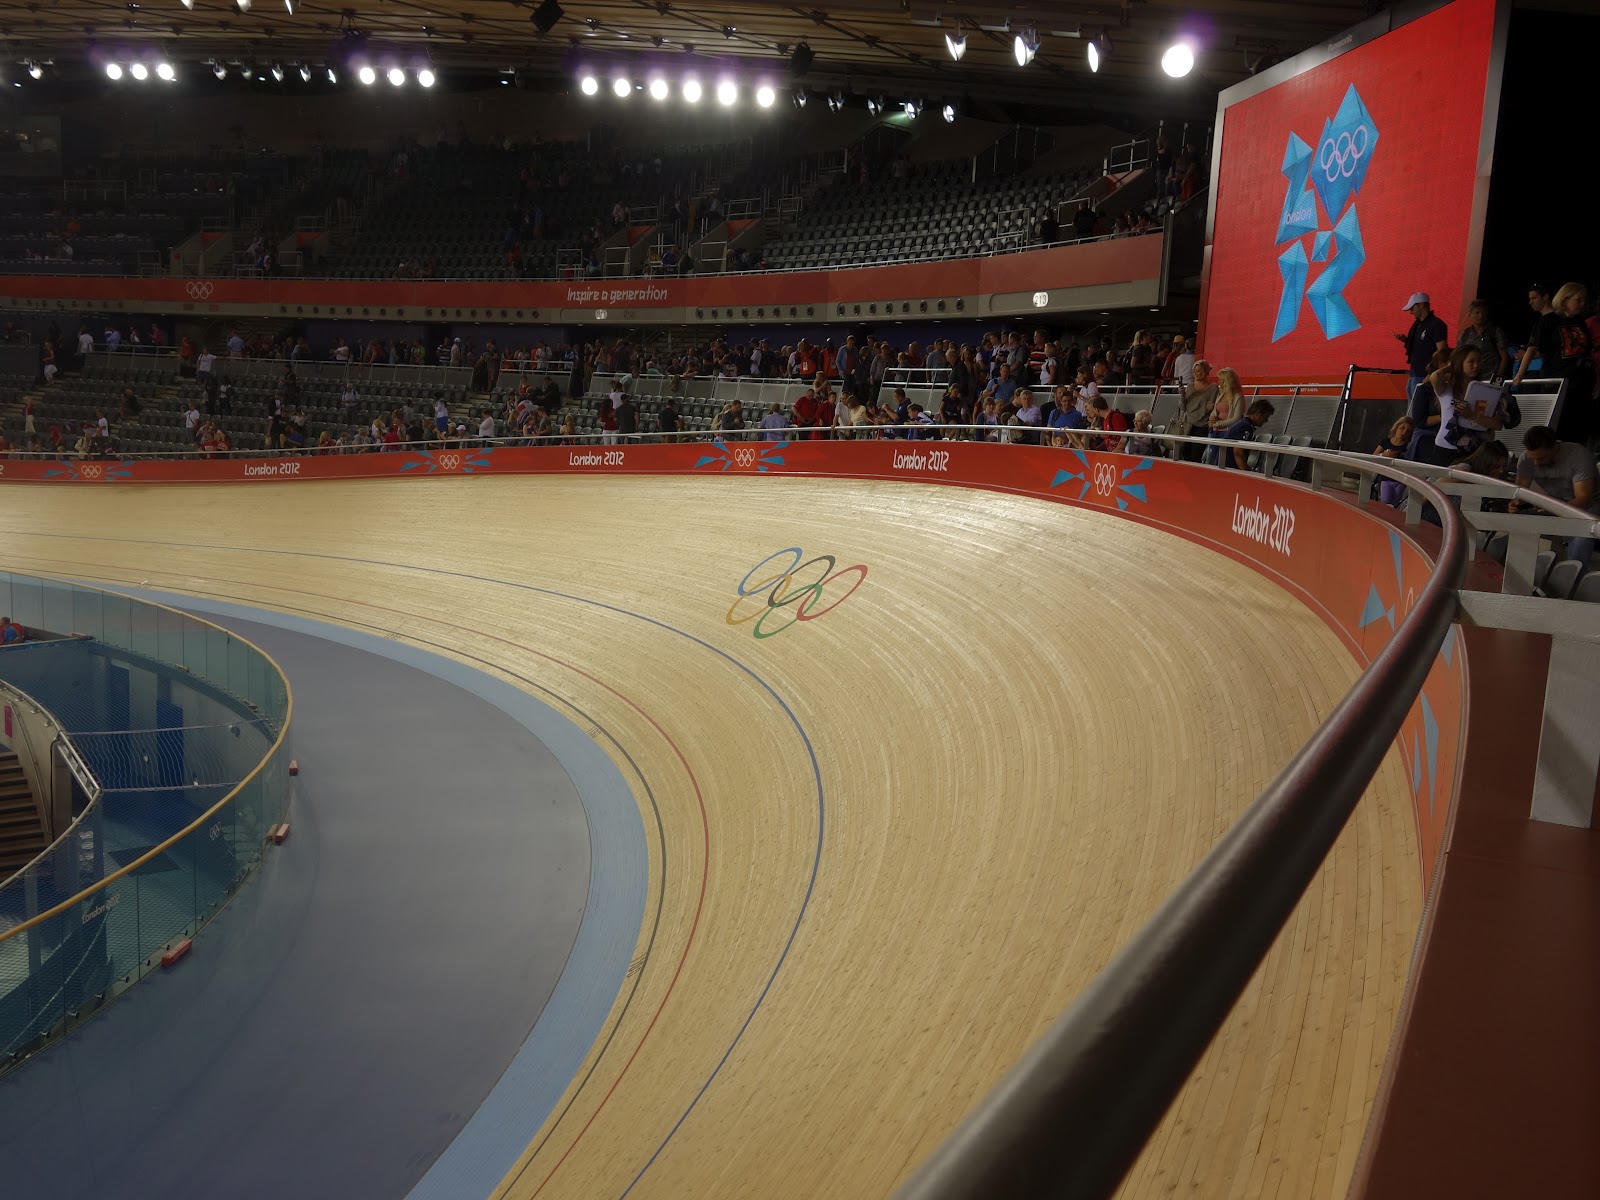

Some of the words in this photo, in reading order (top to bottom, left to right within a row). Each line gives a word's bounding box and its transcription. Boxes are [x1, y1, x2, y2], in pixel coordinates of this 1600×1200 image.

[567, 286, 600, 305] Inspire
[601, 290, 608, 301] a
[609, 284, 668, 305] generation
[1034, 294, 1049, 306] 213
[569, 451, 602, 466] London
[603, 451, 625, 466] 2012
[893, 449, 927, 470] London
[928, 450, 950, 471] 2012
[244, 463, 278, 476] London
[279, 462, 300, 475] 2012
[1232, 492, 1270, 545] London
[1269, 503, 1296, 557] 2012
